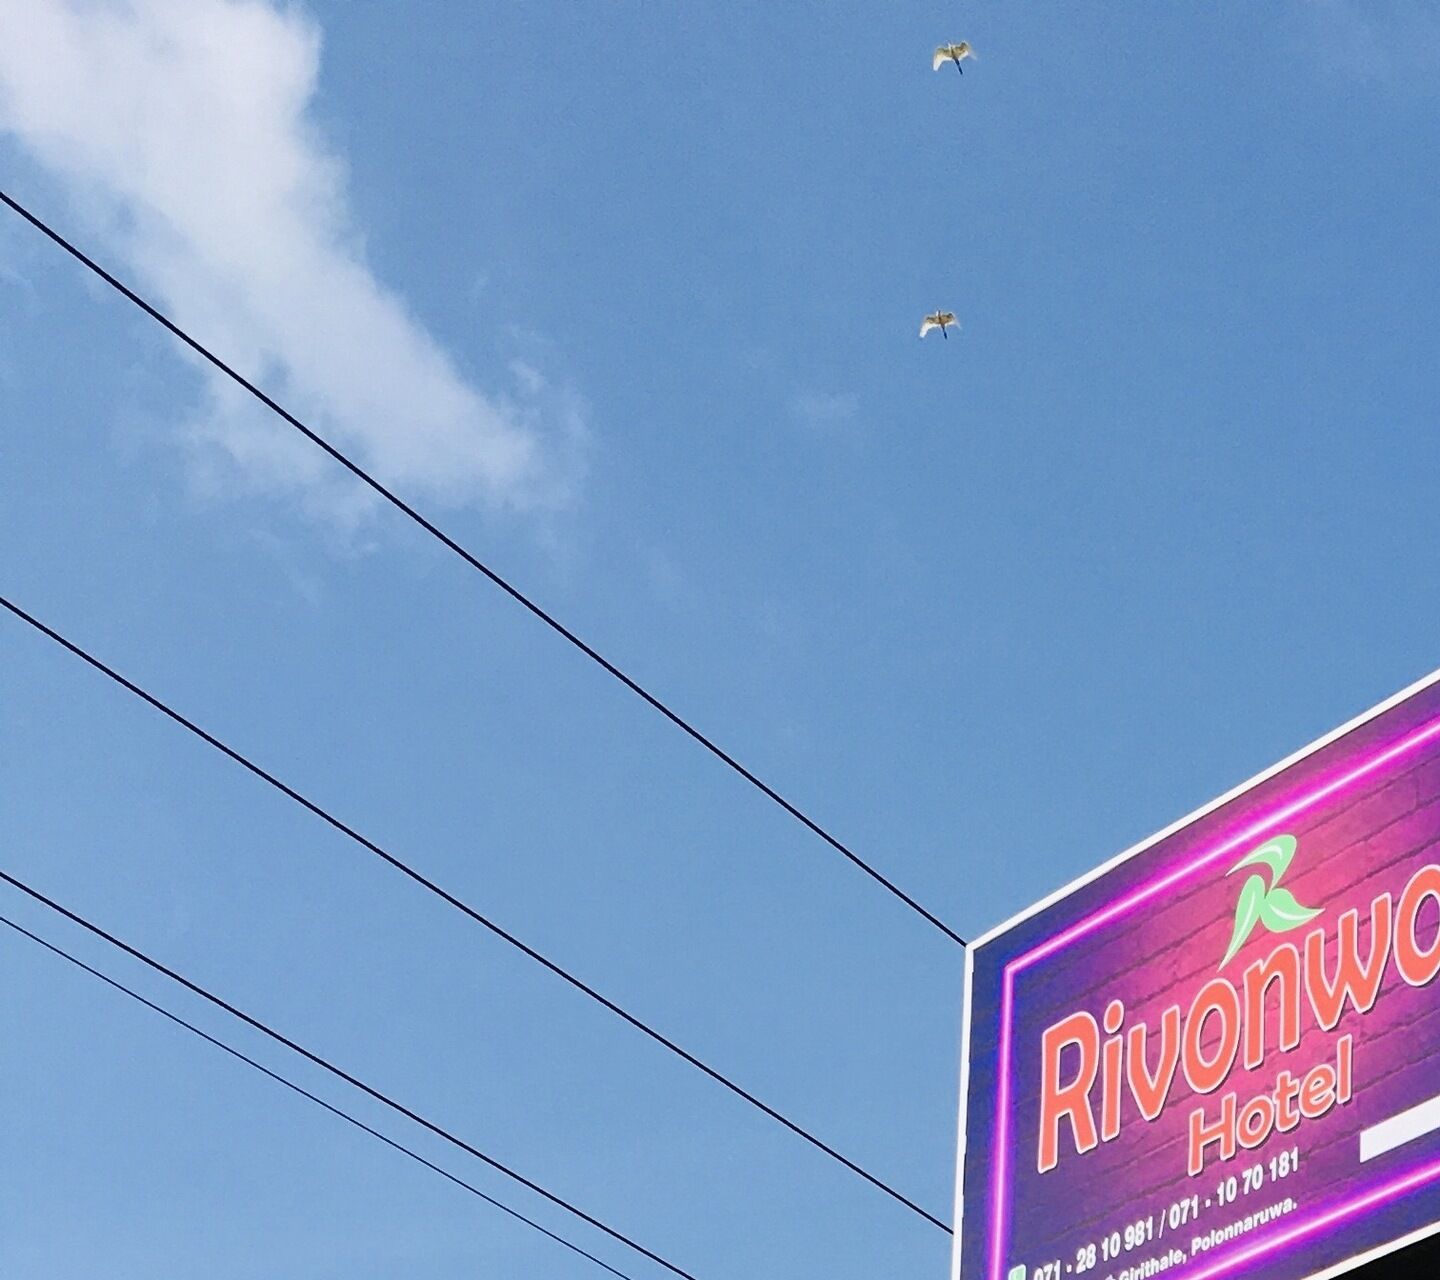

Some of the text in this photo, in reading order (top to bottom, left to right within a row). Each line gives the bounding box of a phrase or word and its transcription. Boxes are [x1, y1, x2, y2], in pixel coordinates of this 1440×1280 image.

[1187, 1033, 1353, 1177] Hotel
[1076, 1243, 1097, 1275] 28
[1103, 1231, 1121, 1262] 10
[1124, 1215, 1154, 1251] 981
[1169, 1194, 1199, 1230] 071
[1217, 1176, 1237, 1207] 10
[1242, 1164, 1264, 1195] 70
[1269, 1146, 1299, 1182] 181
[1191, 1197, 1298, 1256] Polonnaruwa.
